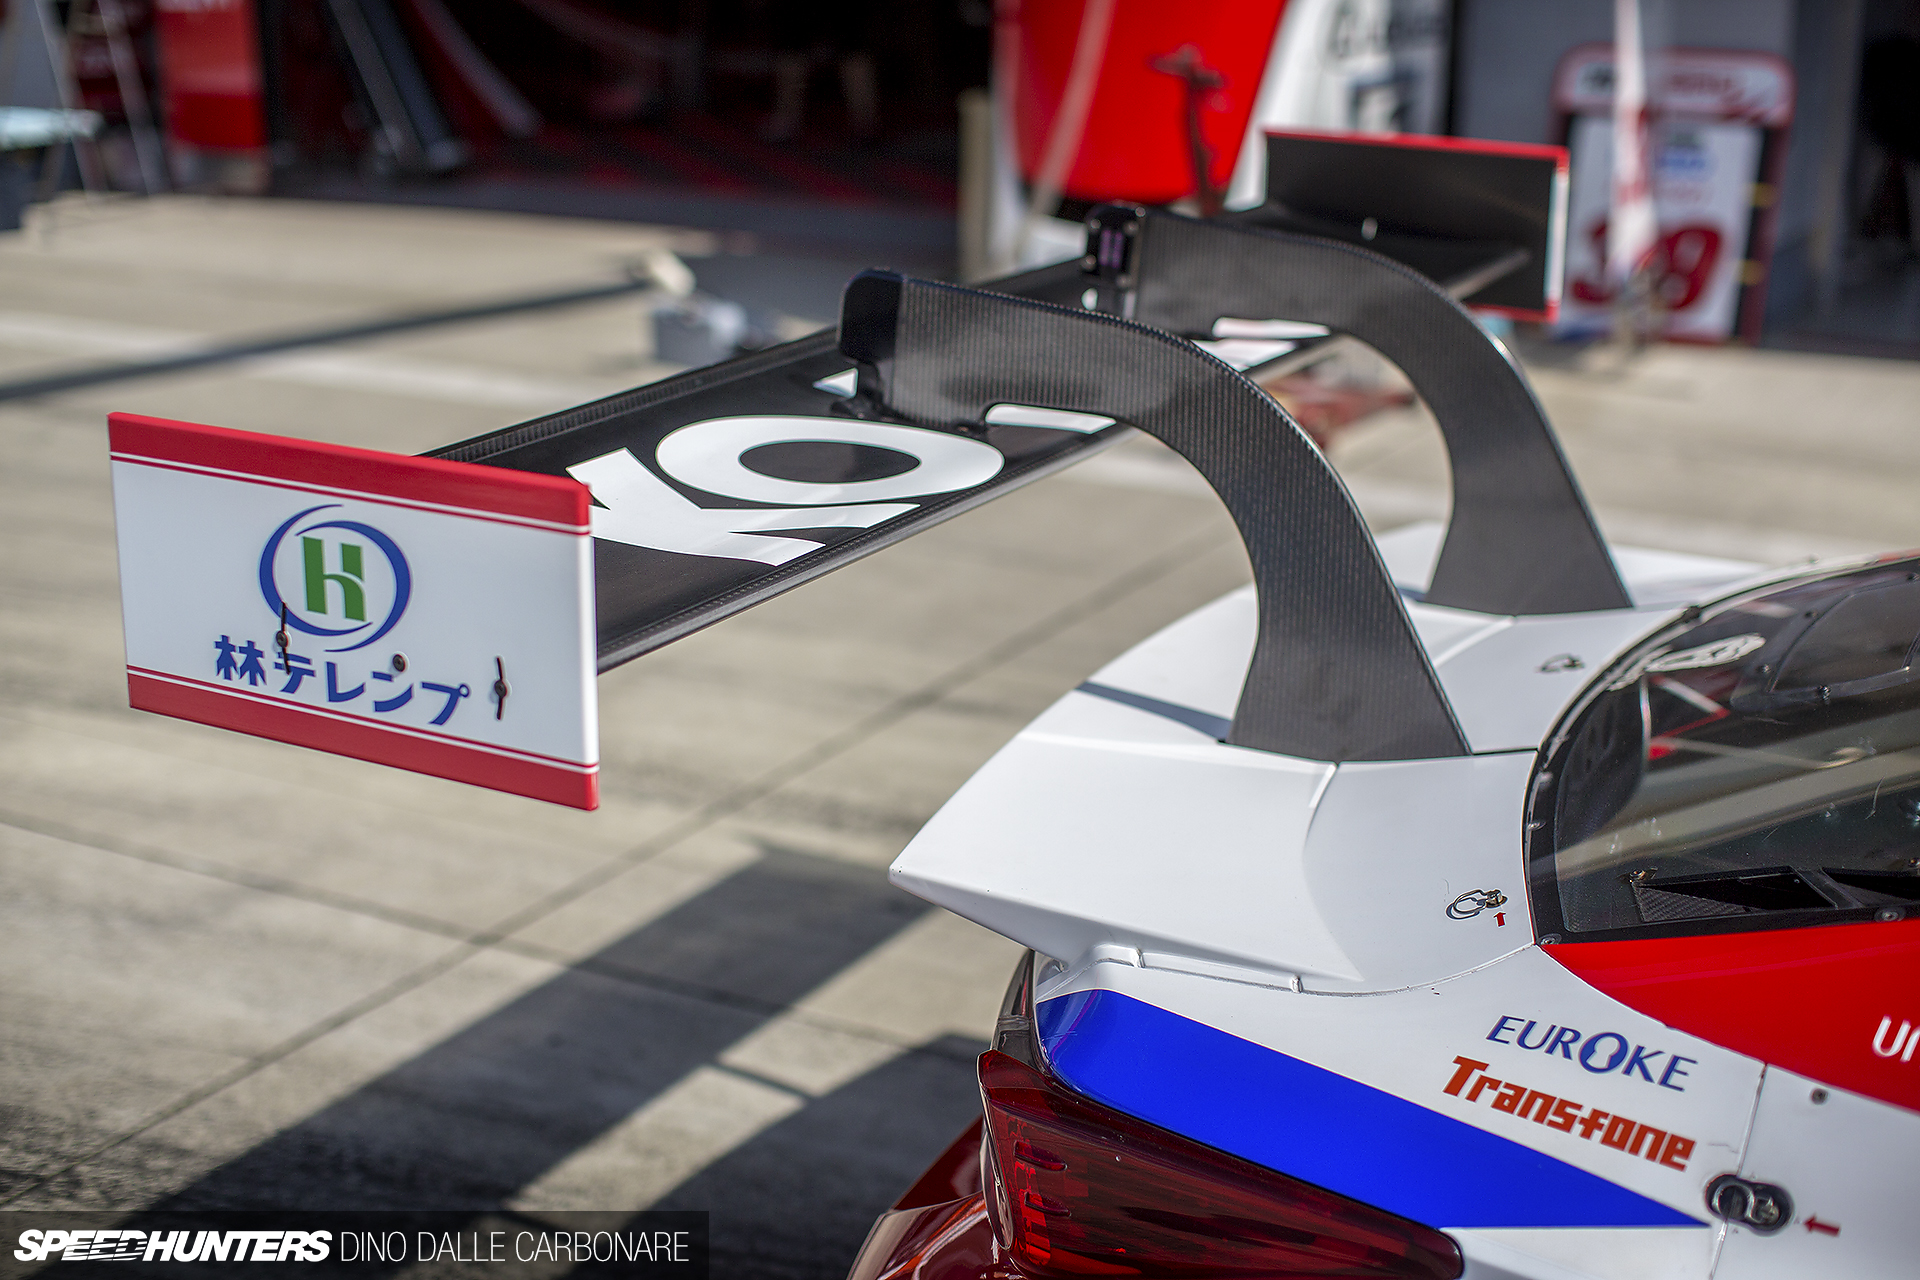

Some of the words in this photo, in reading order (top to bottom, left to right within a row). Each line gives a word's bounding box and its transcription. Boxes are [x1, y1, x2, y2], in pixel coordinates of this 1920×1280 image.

[214, 634, 470, 726] 林テレンプ
[1486, 1014, 1698, 1093] EUROKE
[1443, 1056, 1696, 1172] Transfone
